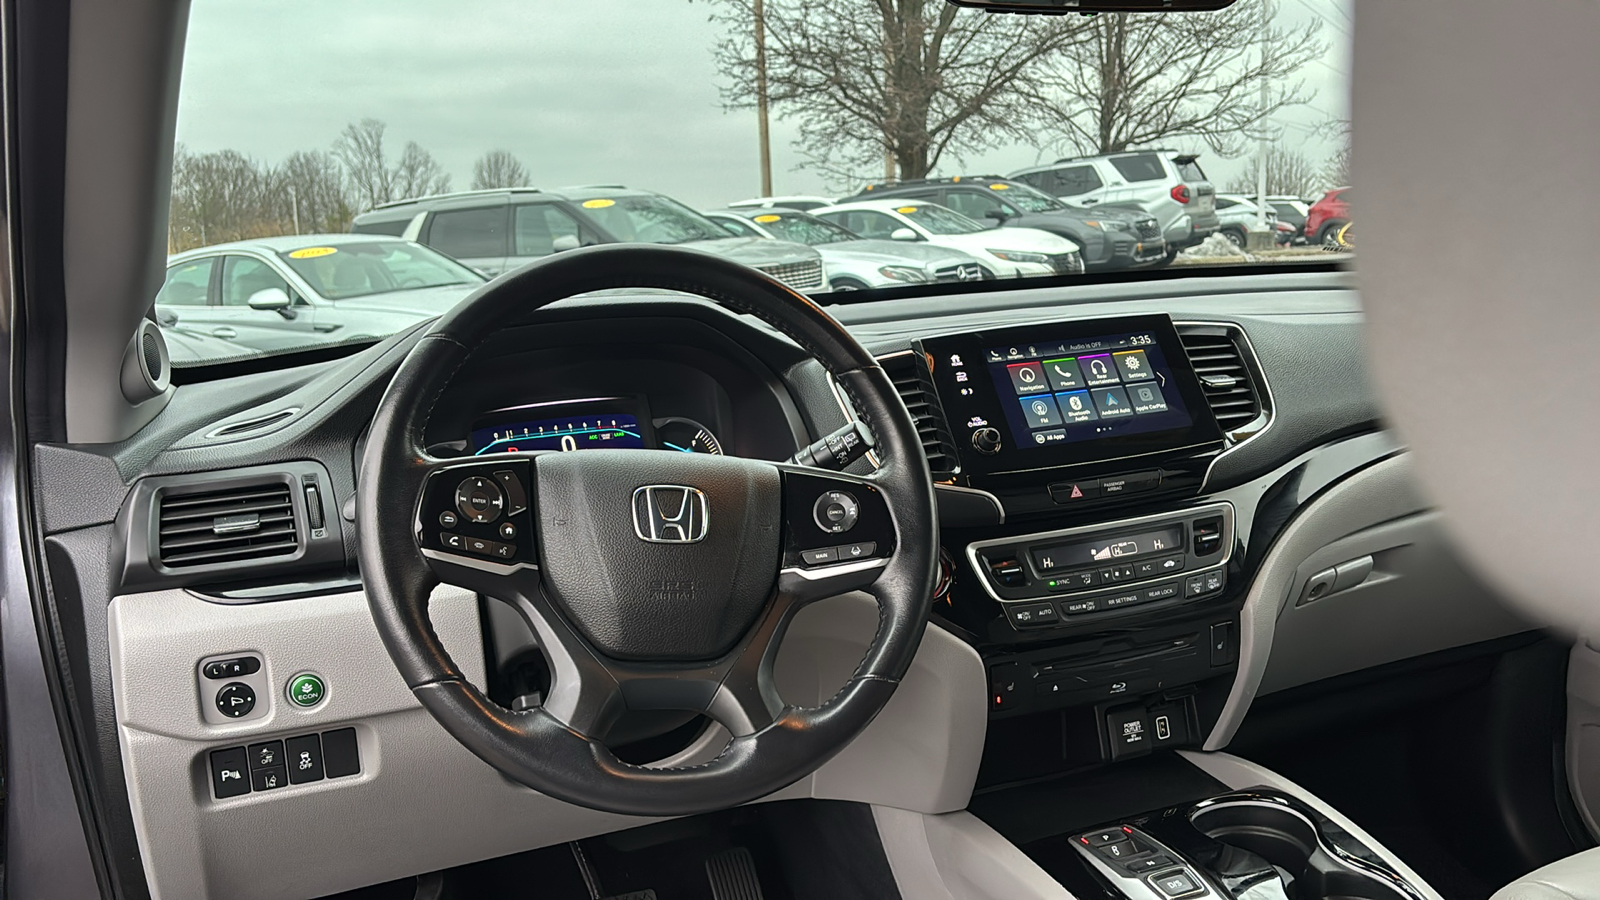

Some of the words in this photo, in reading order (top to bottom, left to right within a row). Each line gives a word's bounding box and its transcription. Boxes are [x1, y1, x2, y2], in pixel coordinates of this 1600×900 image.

[1130, 335, 1151, 345] 3:35
[1088, 377, 1119, 386] Entertainment
[1019, 384, 1045, 392] Navigation
[1068, 409, 1091, 417] Bluetooth
[1136, 405, 1149, 413] Apple
[561, 435, 577, 452] 0
[1056, 578, 1071, 586] SYNC
[1116, 595, 1138, 604] SETTINGS
[1039, 608, 1052, 616] AUTO
[234, 664, 240, 672] R
[298, 692, 319, 700] ECON
[1124, 720, 1141, 728] POWER
[1124, 726, 1142, 734] OUTLET
[261, 757, 274, 765] OFF
[299, 762, 313, 770] OFF
[1167, 879, 1183, 889] D/S
